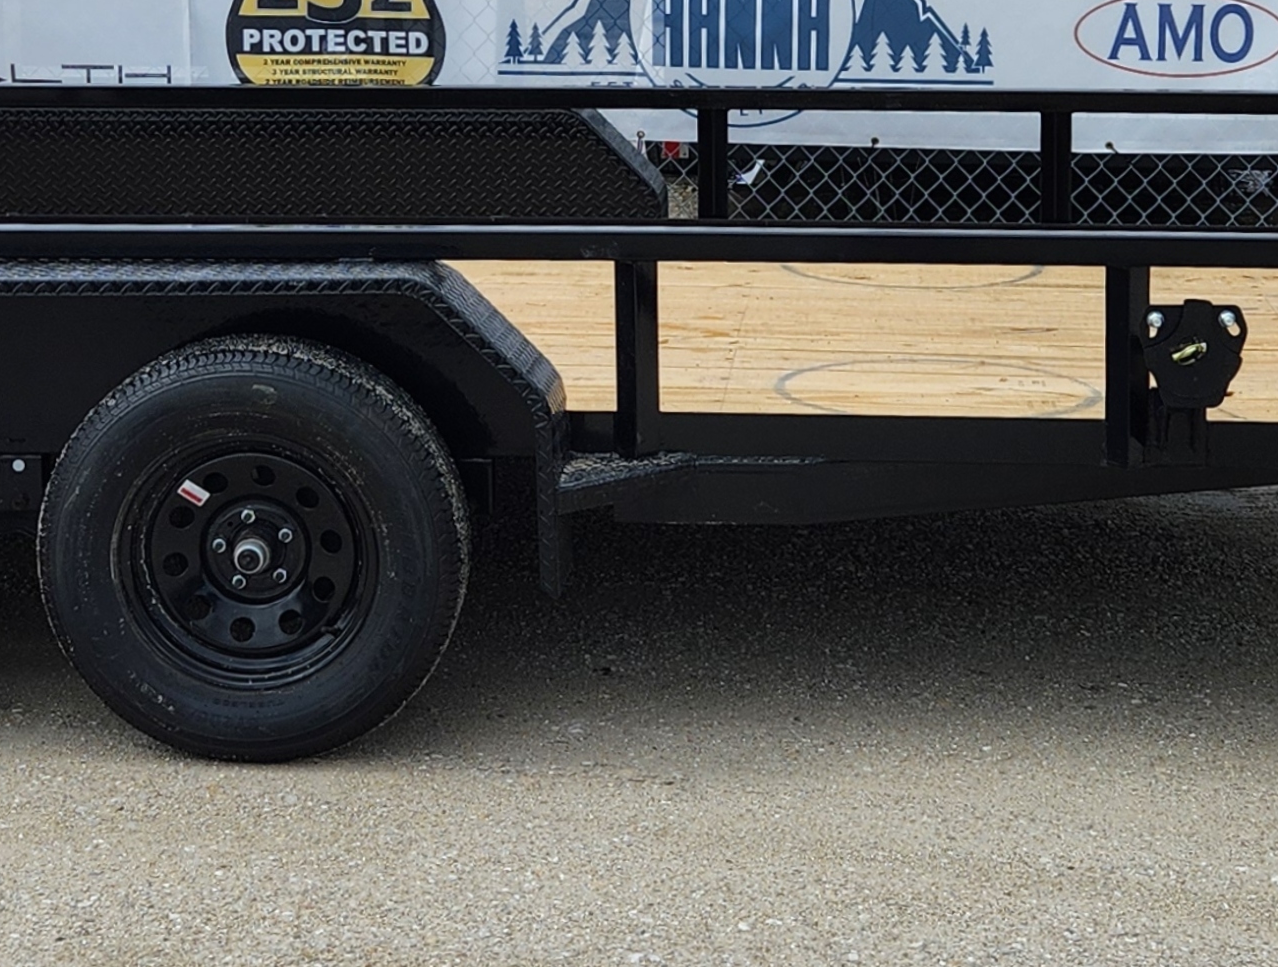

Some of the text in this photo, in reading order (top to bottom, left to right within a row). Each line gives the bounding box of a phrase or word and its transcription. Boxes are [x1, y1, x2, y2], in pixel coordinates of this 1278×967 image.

[242, 28, 429, 54] PROTECTED
[1106, 2, 1254, 64] AMO
[363, 59, 407, 67] WARRANTY
